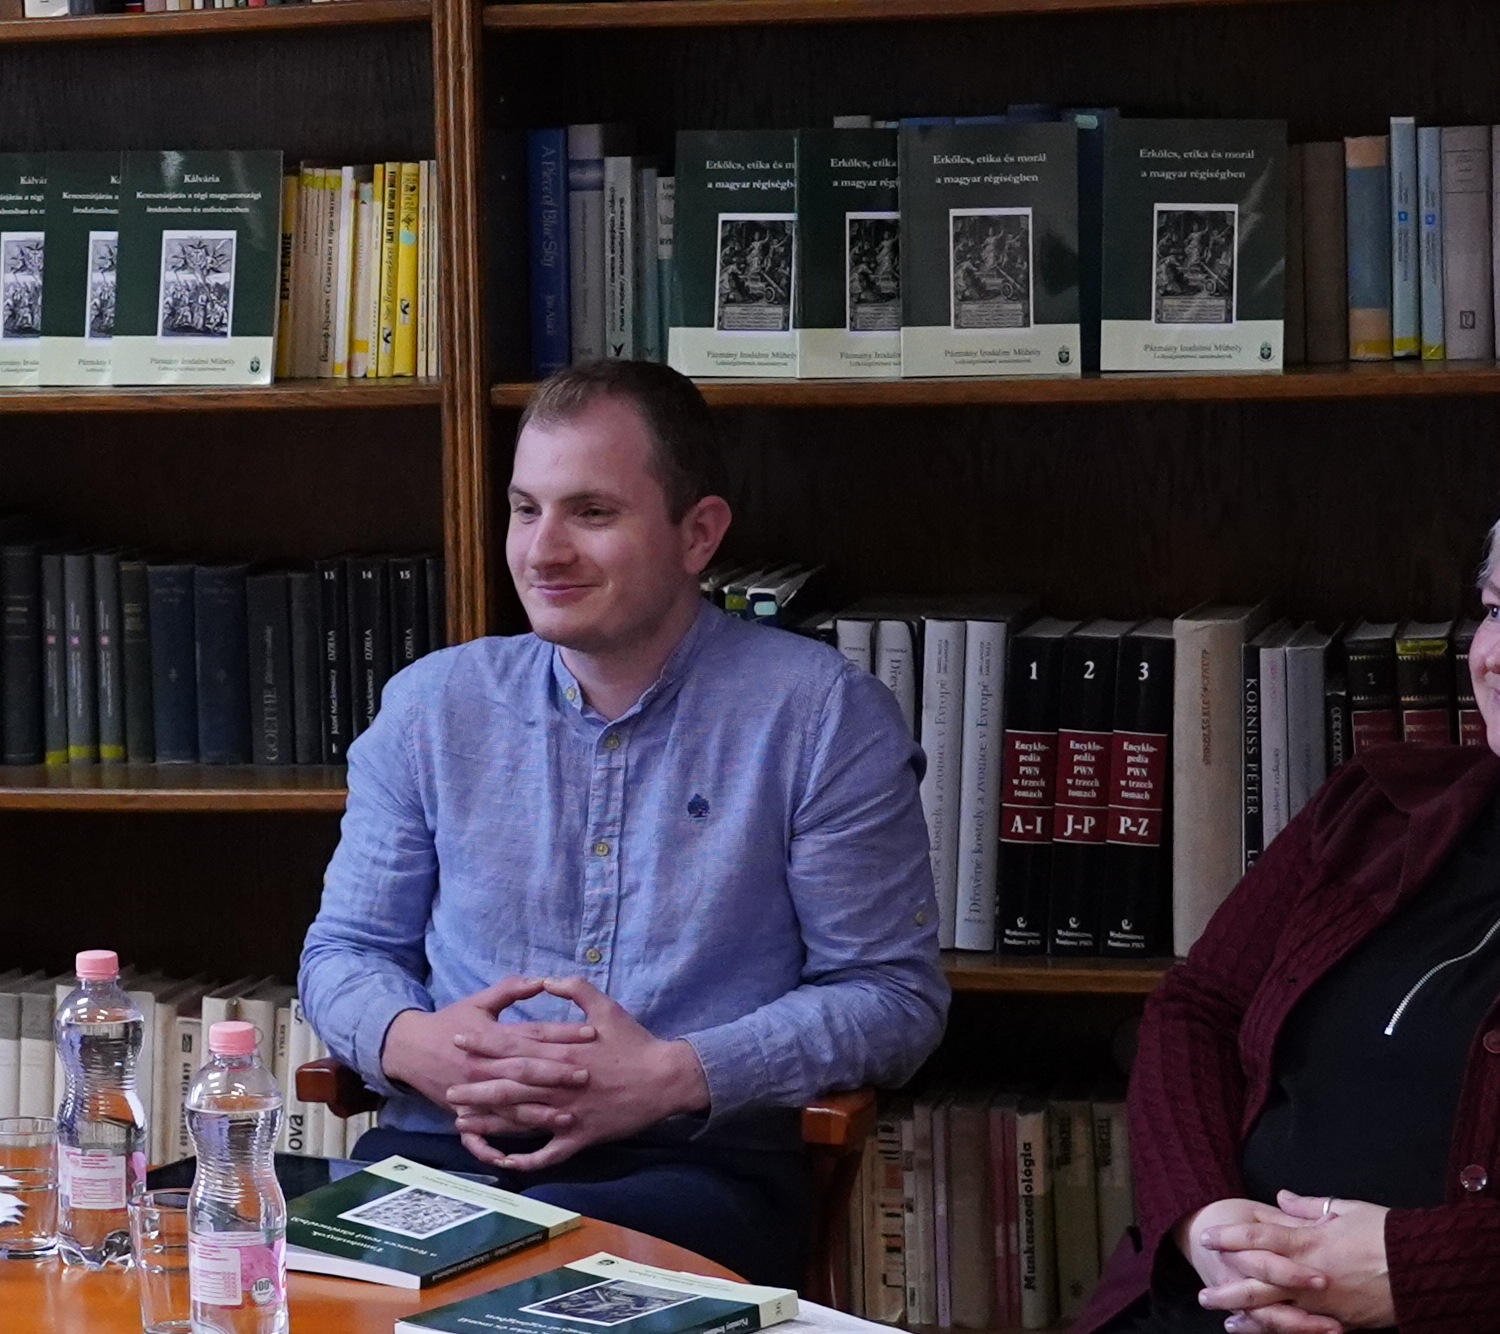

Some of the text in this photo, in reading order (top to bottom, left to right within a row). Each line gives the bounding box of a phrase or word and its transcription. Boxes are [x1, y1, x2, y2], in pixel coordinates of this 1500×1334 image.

[933, 152, 1046, 165] Erkölcs, etika és morál
[1139, 148, 1255, 160] Erkölcs, etika és morál
[746, 160, 771, 170] etika
[772, 160, 785, 169] és
[183, 173, 220, 184] Kálvária
[943, 176, 981, 187] magyar
[983, 173, 1039, 185] régiségben
[1149, 171, 1188, 182] magyar
[1189, 168, 1246, 182] régiségben
[714, 181, 751, 192] magyar
[840, 180, 876, 190] magyar
[1144, 344, 1178, 355] Pázmány
[1213, 344, 1242, 355] Műhely
[361, 571, 373, 580] 14
[1029, 661, 1039, 680] 1
[1083, 661, 1095, 680] 2
[1138, 662, 1150, 681] 3
[1014, 740, 1050, 752] Encyklo-
[1069, 740, 1105, 752] Encyklo-
[1122, 741, 1158, 754] Encyklo-
[1245, 678, 1260, 815] KORNISS PÉTER
[1018, 753, 1041, 764] pedia
[1073, 752, 1096, 763] pedia
[1127, 754, 1149, 764] pedia
[1019, 766, 1041, 776] PWN
[1073, 766, 1095, 776] PWN
[1127, 767, 1148, 778] PWN
[1012, 778, 1046, 787] w trzech
[1066, 778, 1100, 788] w trzech
[1128, 780, 1154, 789] trzech
[1014, 789, 1043, 799] tomach
[1068, 789, 1097, 799] tomach
[1121, 790, 1151, 800] tomach
[1011, 815, 1043, 835] A-I
[1064, 814, 1096, 836] J-P
[1119, 815, 1149, 836] P-Z
[1022, 1140, 1039, 1291] Munkaszociológia
